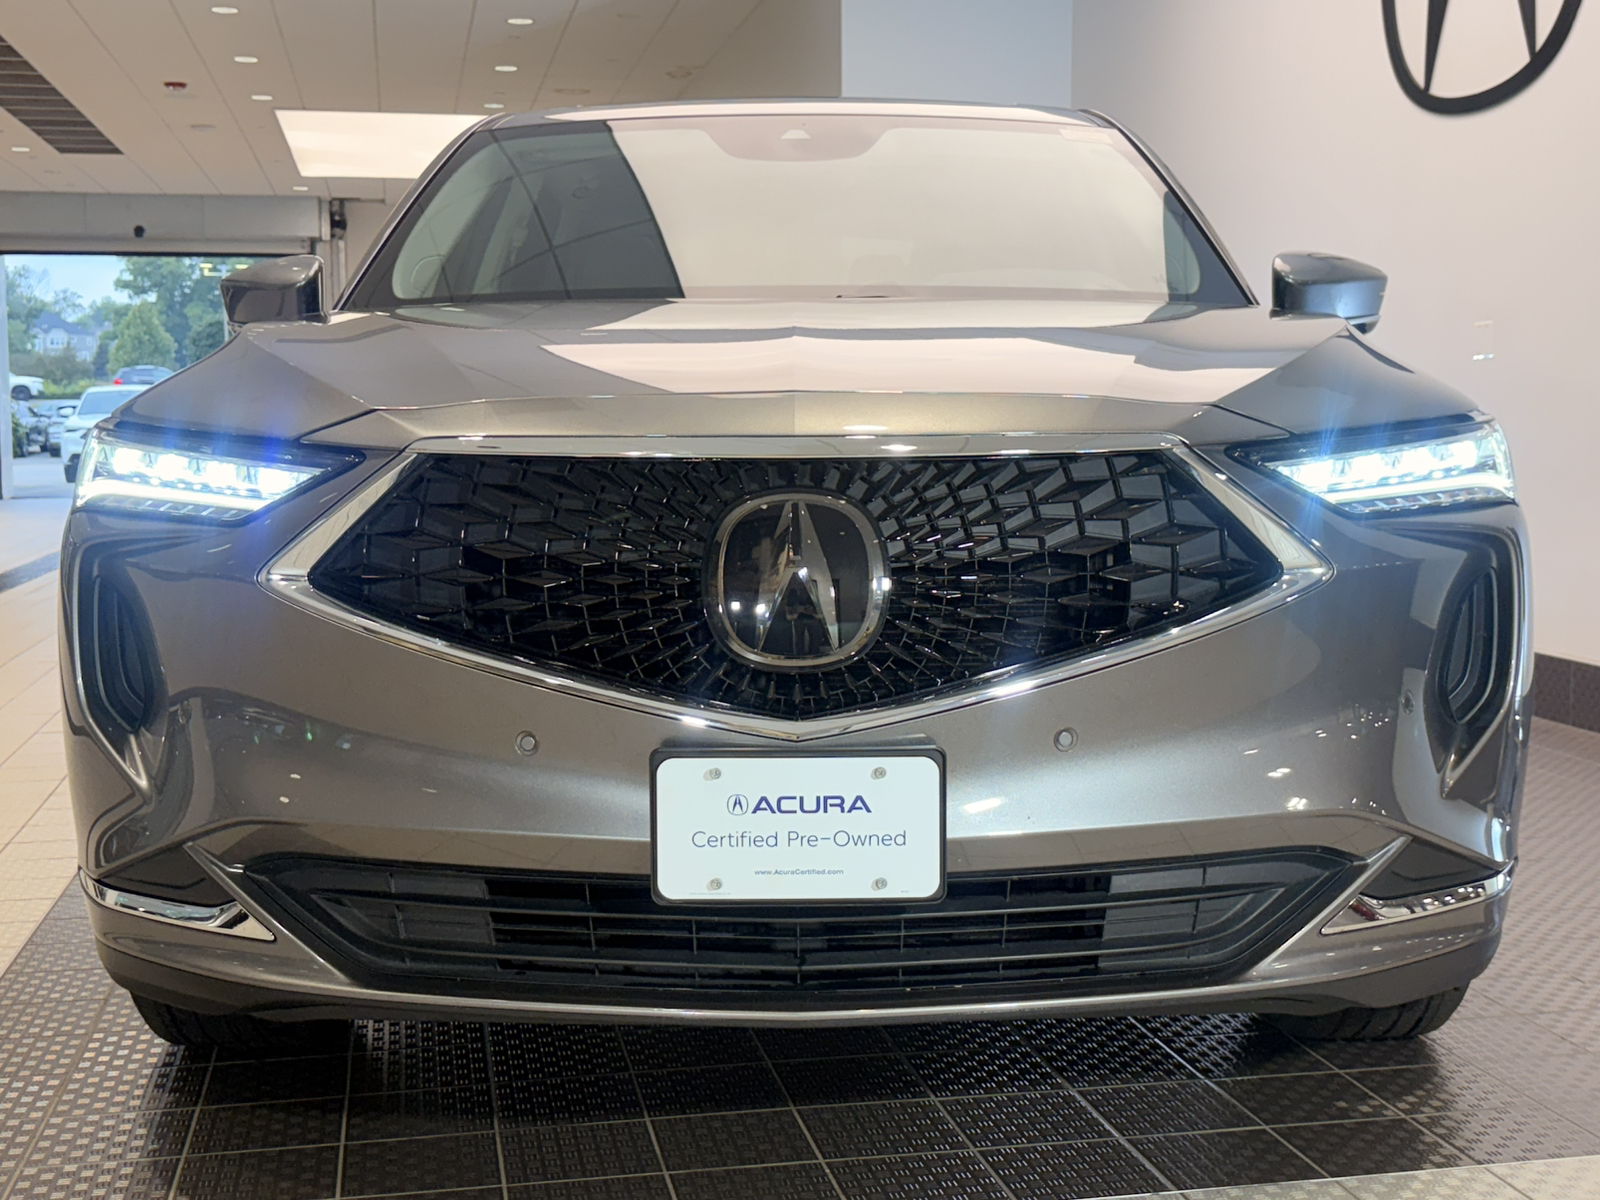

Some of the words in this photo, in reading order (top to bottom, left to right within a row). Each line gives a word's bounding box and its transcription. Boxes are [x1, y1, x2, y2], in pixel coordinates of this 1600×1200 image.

[751, 795, 872, 814] ACURA
[691, 831, 778, 848] Certified
[787, 830, 907, 847] Pre-Owned
